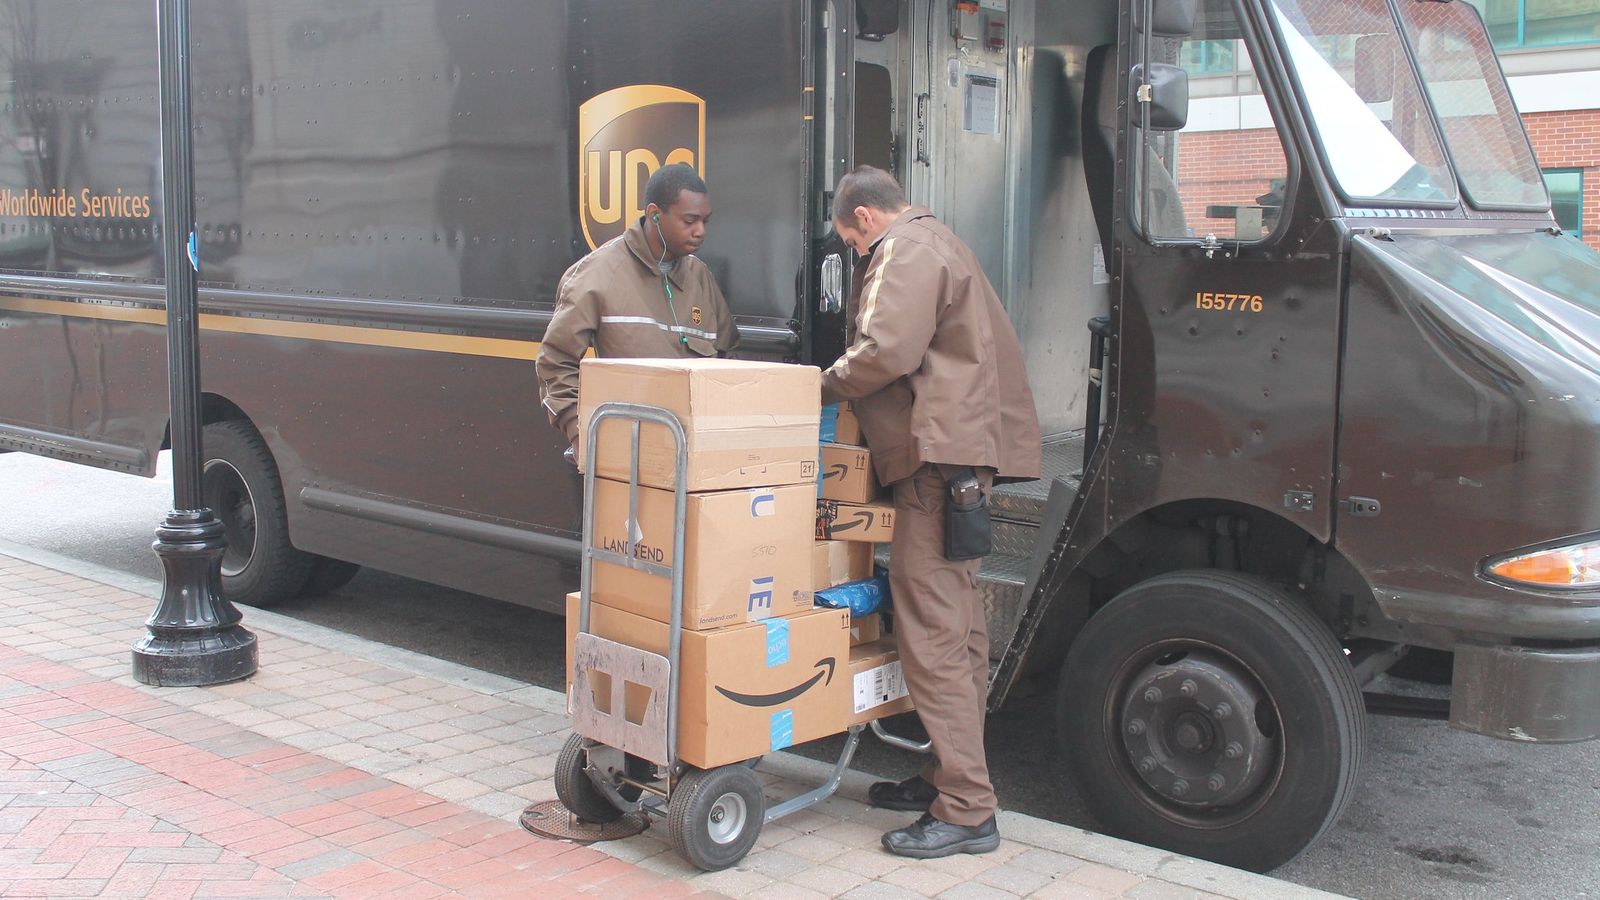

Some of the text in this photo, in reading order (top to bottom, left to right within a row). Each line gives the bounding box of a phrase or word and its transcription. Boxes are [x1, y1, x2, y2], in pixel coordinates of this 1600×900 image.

[0, 187, 150, 218] Worldwide Services
[589, 148, 694, 231] up
[1196, 292, 1263, 313] 155776
[802, 465, 811, 473] 21
